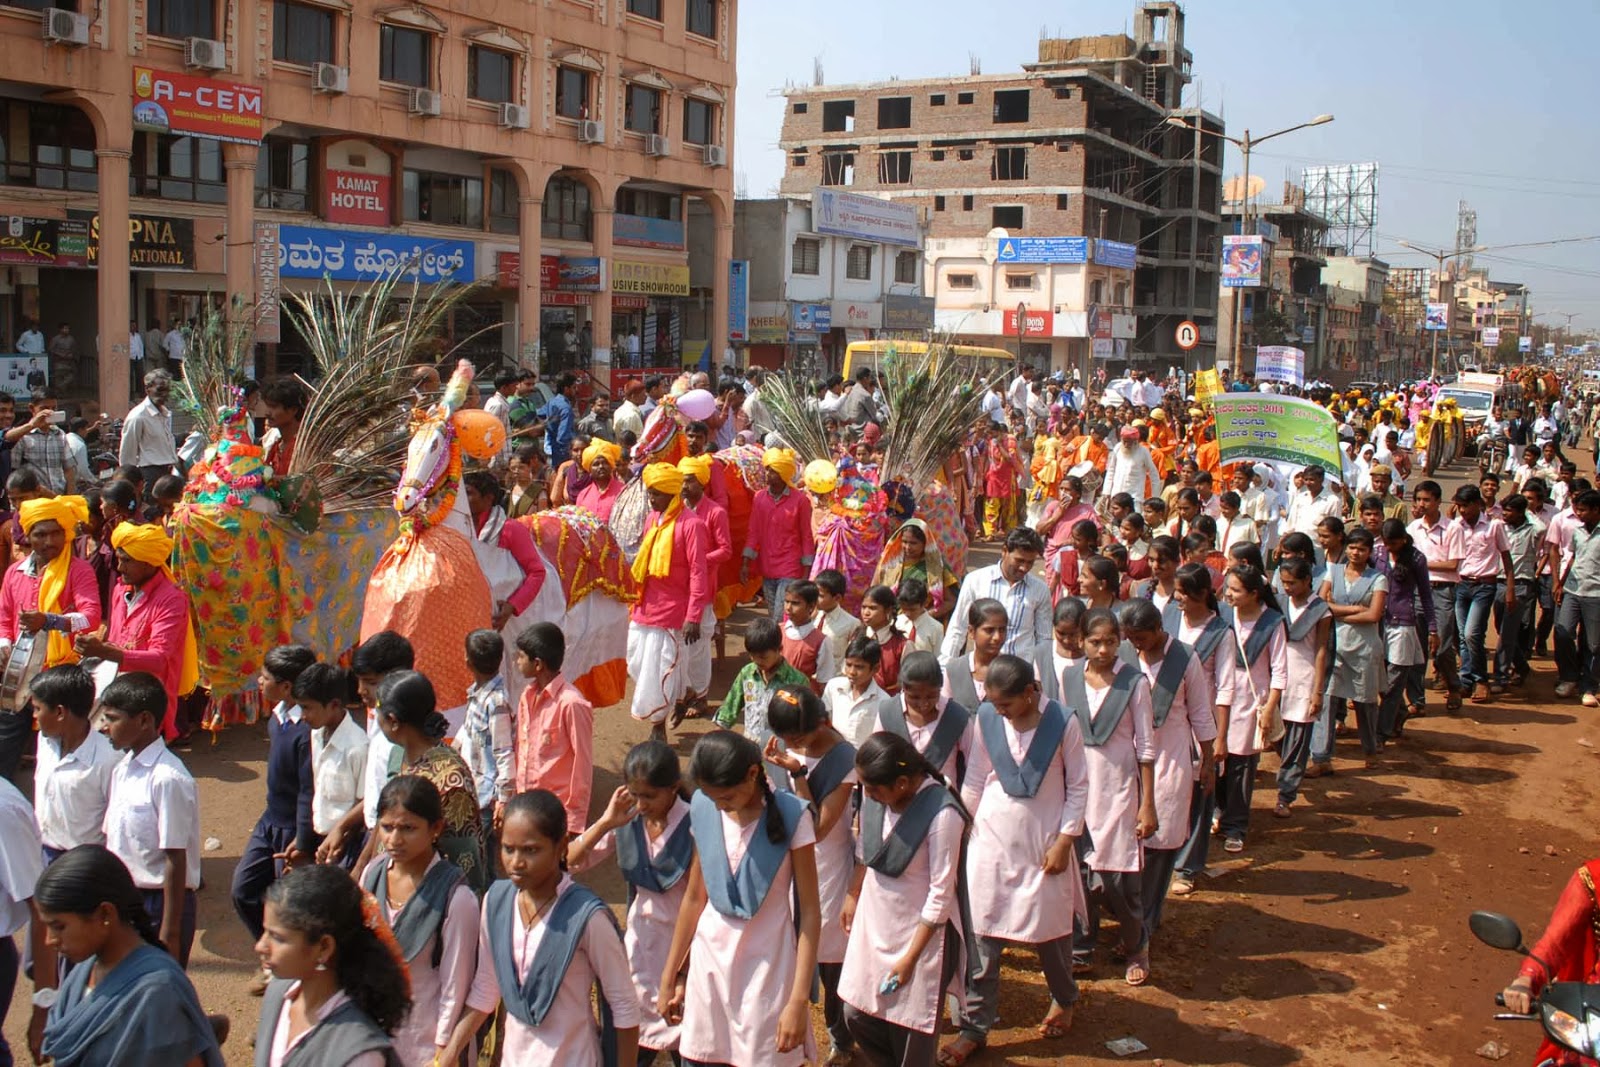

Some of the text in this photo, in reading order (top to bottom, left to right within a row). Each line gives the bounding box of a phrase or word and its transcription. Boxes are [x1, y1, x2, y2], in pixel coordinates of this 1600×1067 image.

[153, 79, 261, 115] A-CEM
[337, 176, 379, 193] KAMAT
[331, 192, 385, 212] HOTEL
[91, 215, 176, 244] SPNA
[87, 246, 184, 265] NATIONAL
[612, 280, 639, 291] USIVE
[640, 281, 687, 293] SHOWROOM
[1262, 405, 1285, 414] 2014
